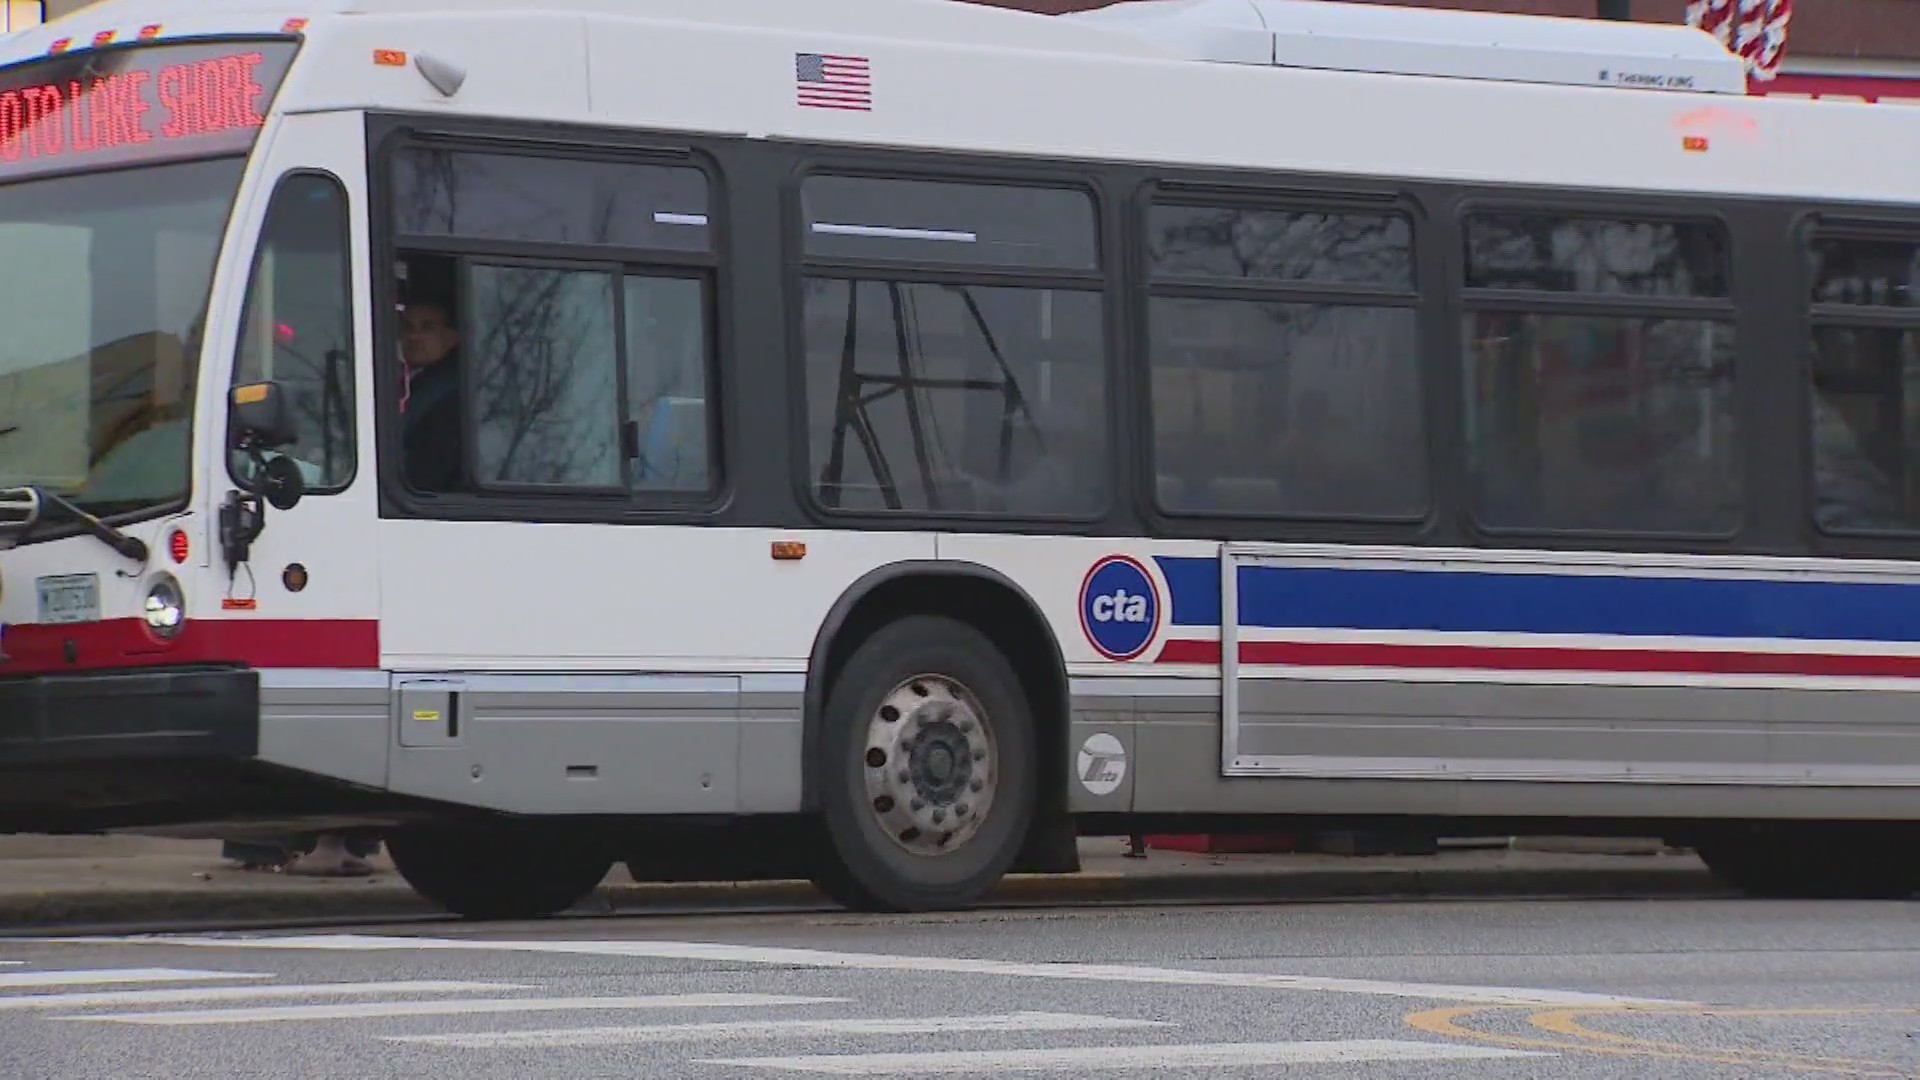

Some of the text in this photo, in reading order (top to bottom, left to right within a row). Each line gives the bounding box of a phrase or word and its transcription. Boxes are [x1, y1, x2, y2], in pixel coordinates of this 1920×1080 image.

[69, 70, 152, 151] LAKE
[158, 52, 265, 138] SHORE
[1092, 589, 1147, 622] cta
